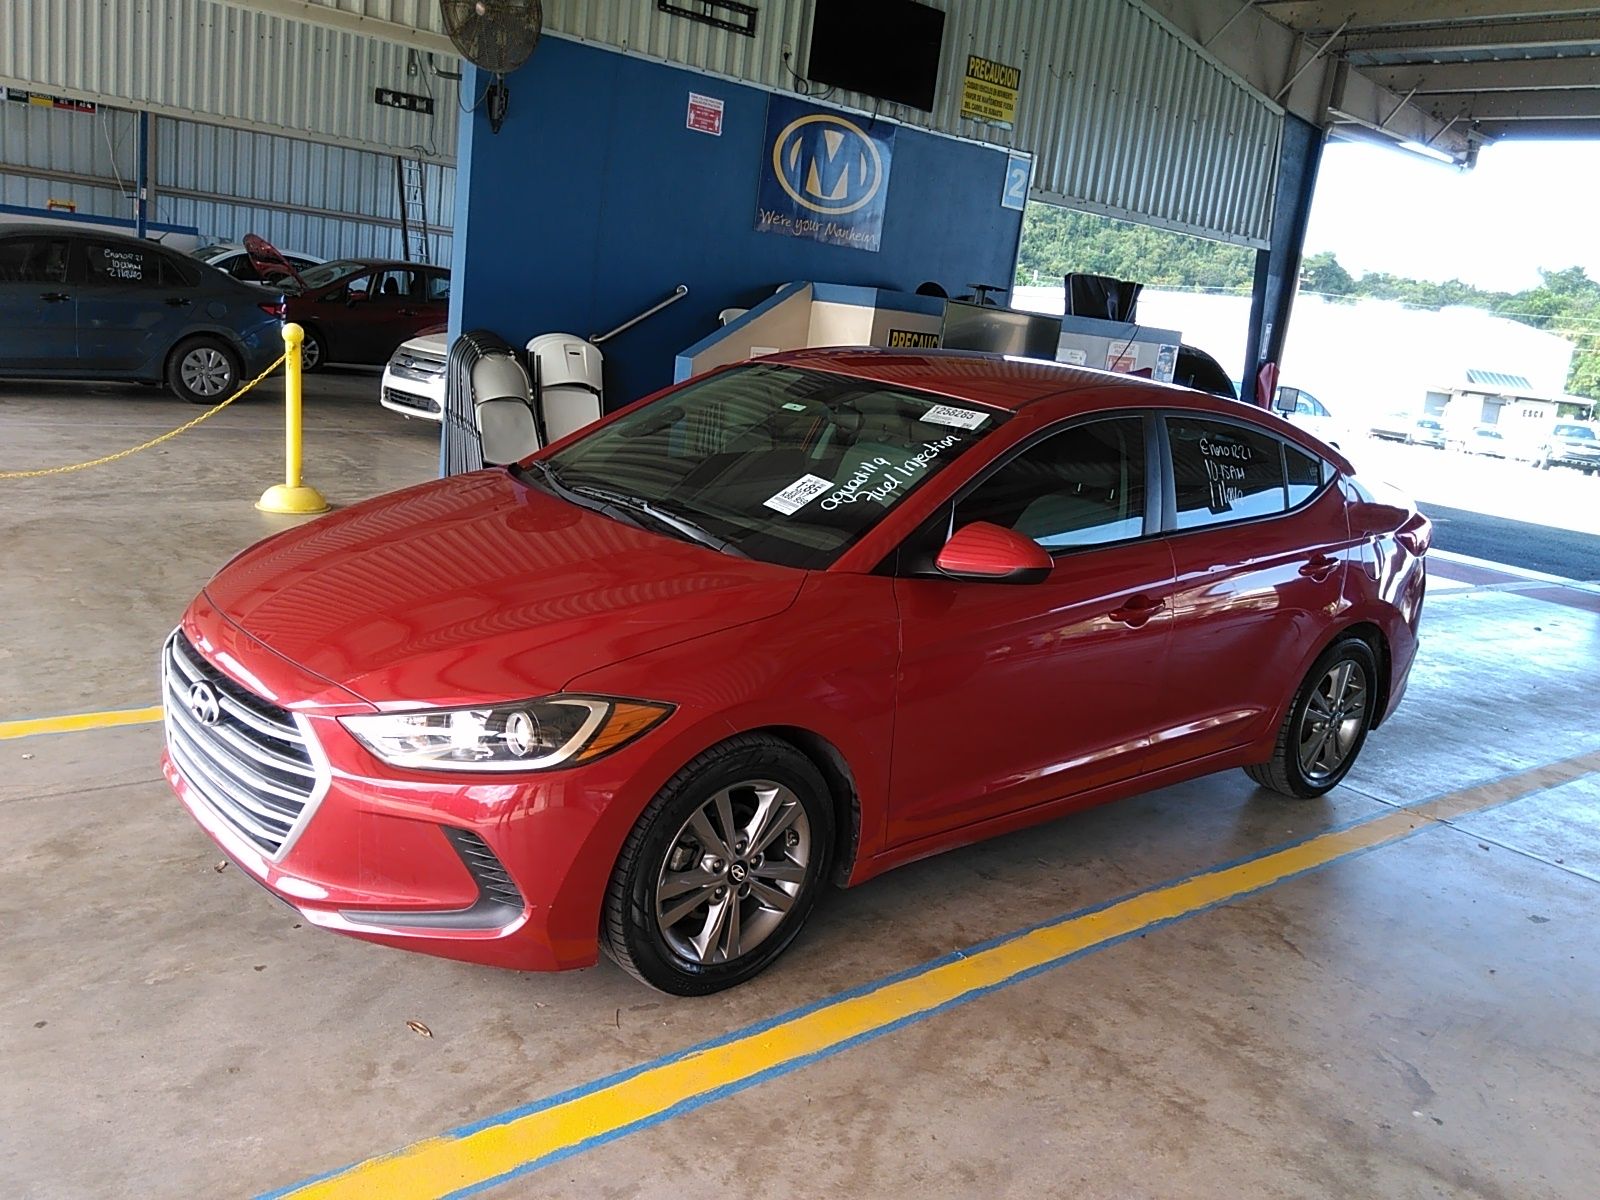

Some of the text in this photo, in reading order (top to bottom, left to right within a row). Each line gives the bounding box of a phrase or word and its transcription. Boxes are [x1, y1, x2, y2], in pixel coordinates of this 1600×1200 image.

[969, 57, 1018, 88] PRECAUCION
[1008, 168, 1025, 198] 2
[760, 208, 876, 242] We're your Manheim
